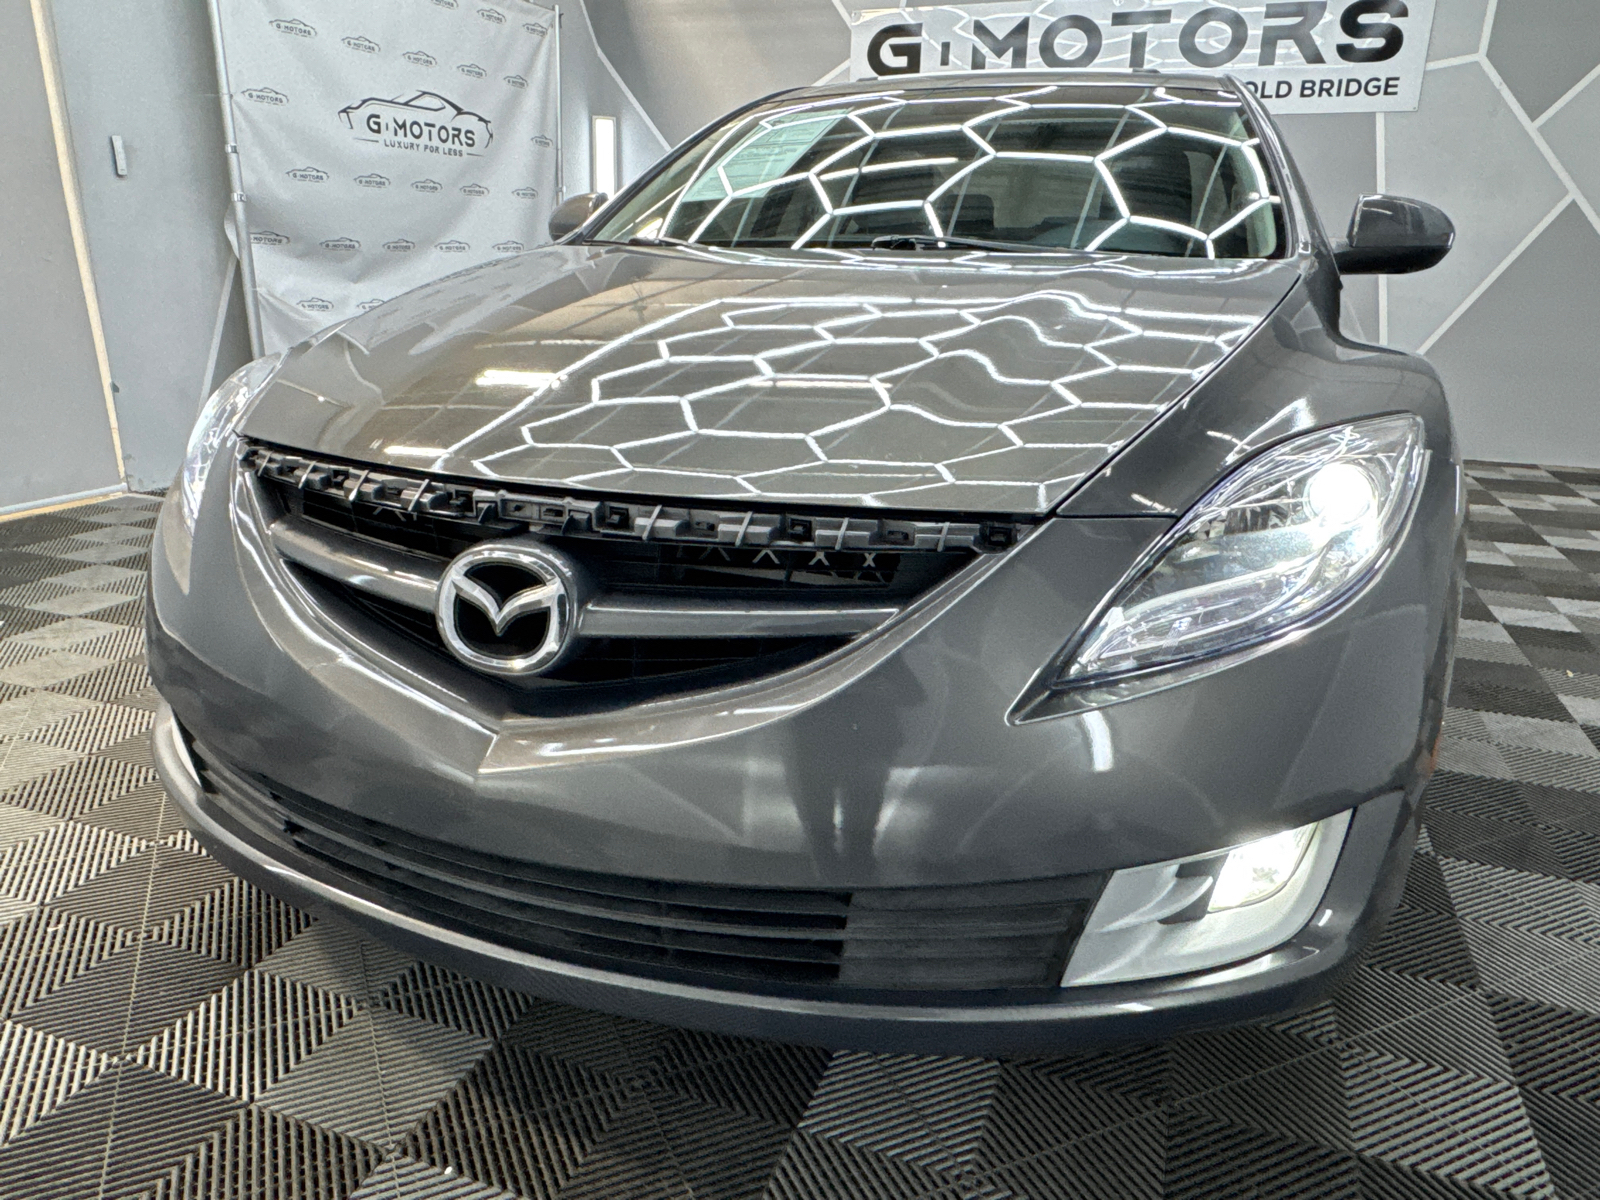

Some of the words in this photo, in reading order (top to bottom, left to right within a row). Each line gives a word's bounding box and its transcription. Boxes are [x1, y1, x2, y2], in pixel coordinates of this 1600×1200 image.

[284, 25, 311, 36] MOTORS
[971, 0, 1408, 69] MOTORS
[353, 42, 376, 52] MOTORS
[413, 57, 433, 65] MOTORS
[1300, 76, 1400, 98] BRIDGE
[256, 94, 283, 104] MOTORS
[393, 117, 475, 148] MOTORS
[384, 139, 420, 152] LUXURY
[424, 144, 440, 154] FOR
[443, 148, 463, 157] LESS
[253, 236, 282, 244] MOTORS
